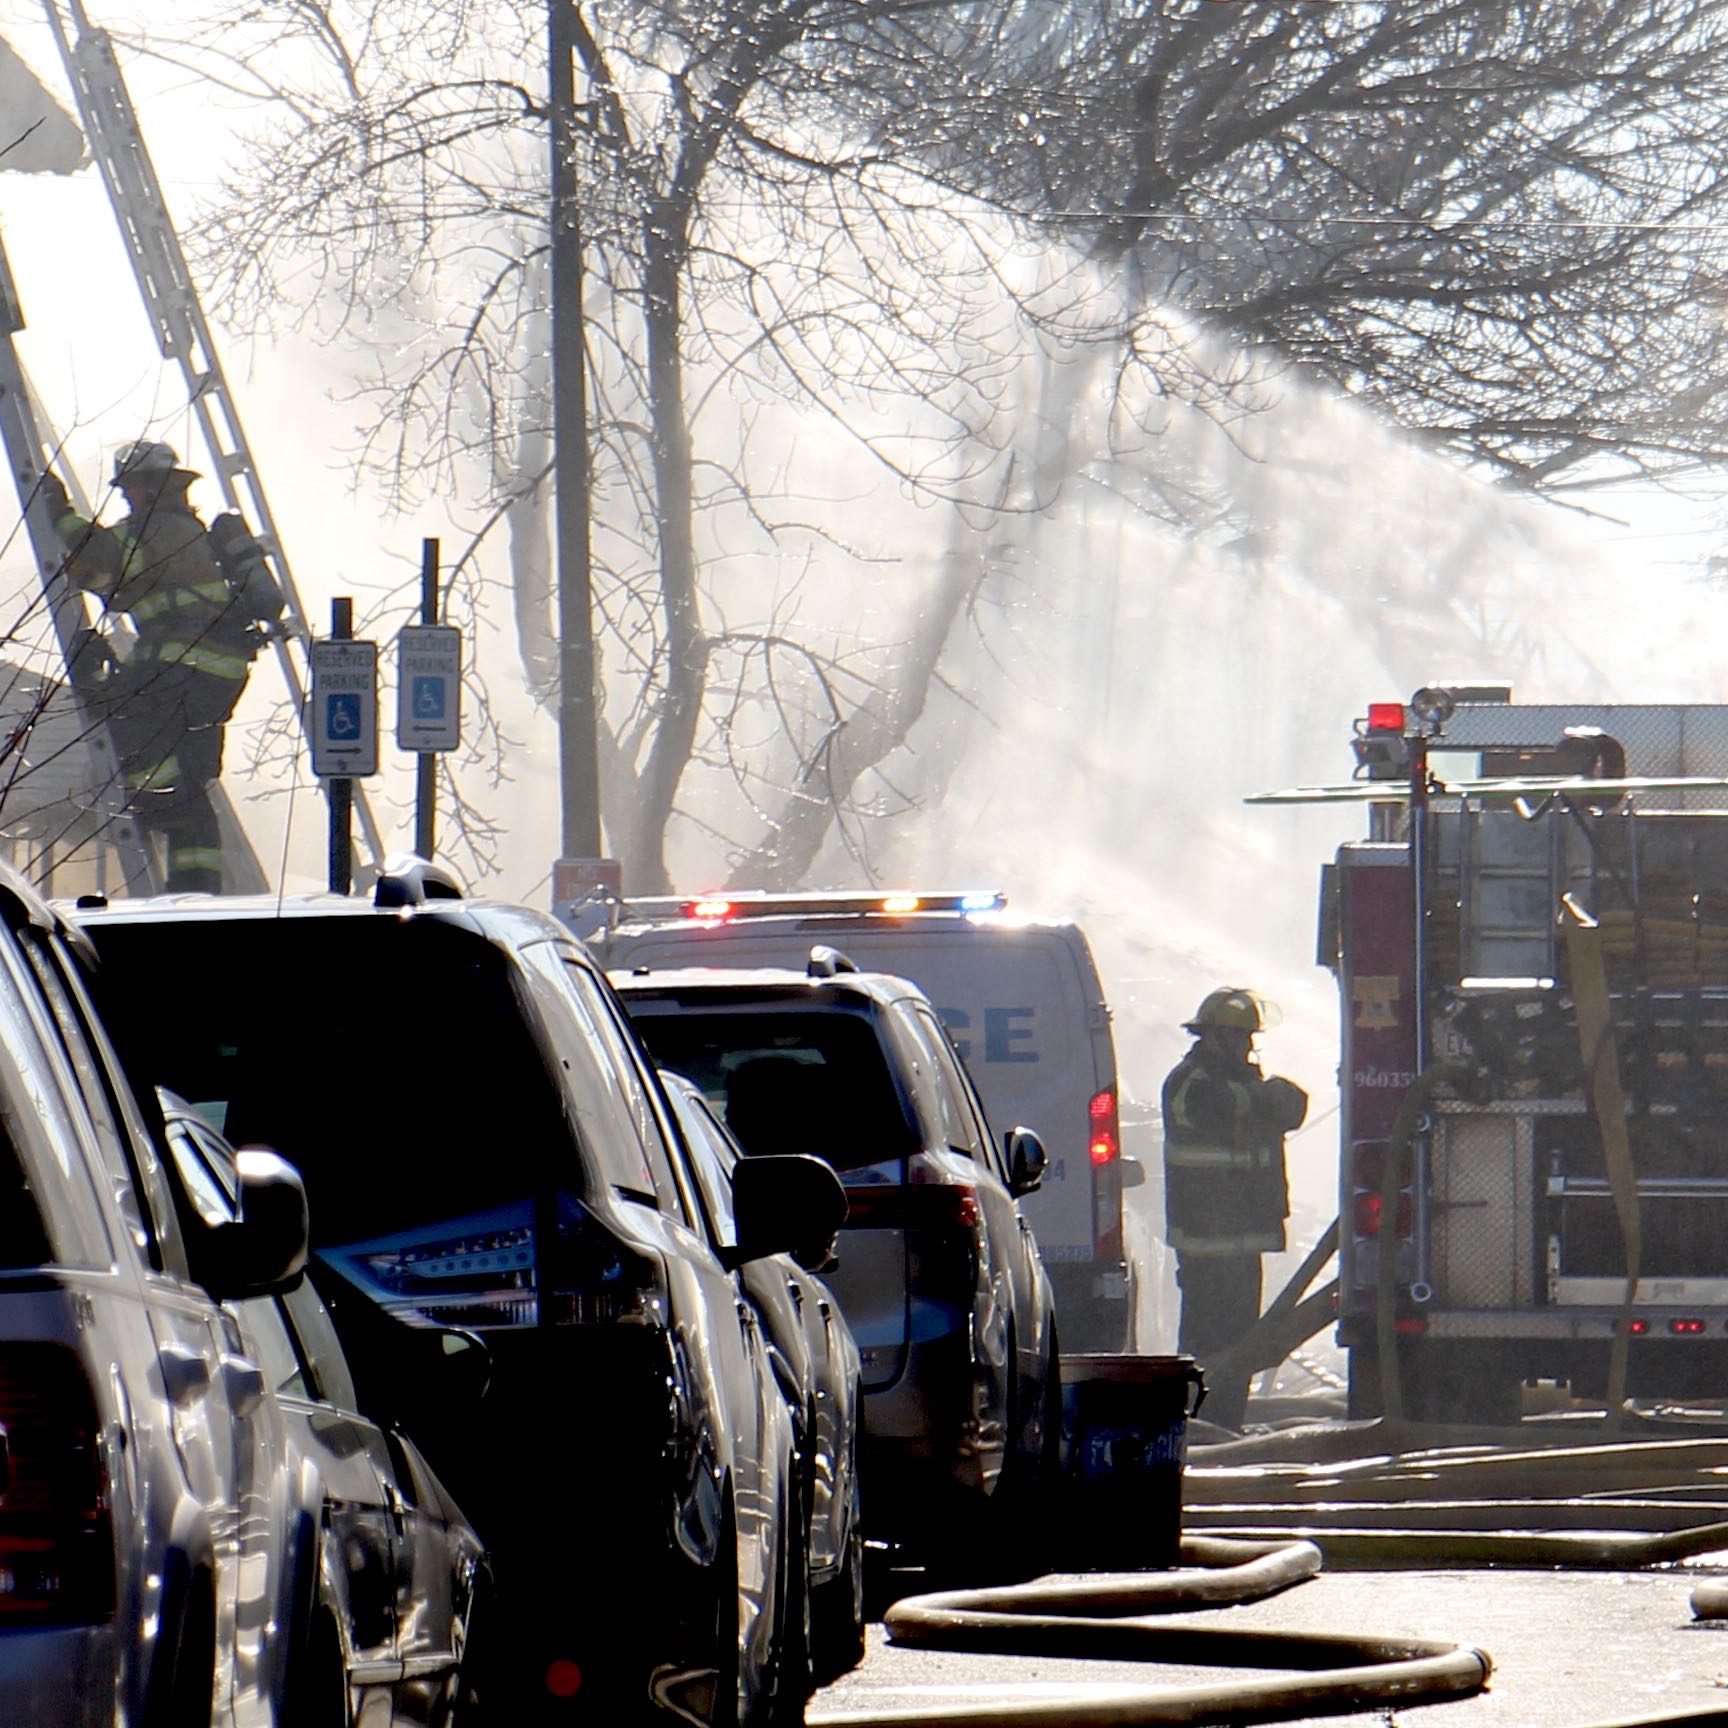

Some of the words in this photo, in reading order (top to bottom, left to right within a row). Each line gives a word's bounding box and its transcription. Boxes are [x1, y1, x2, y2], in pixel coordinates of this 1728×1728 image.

[405, 636, 456, 652] RESERVED
[316, 650, 373, 668] RESERVED
[406, 657, 453, 674] PARKING
[319, 674, 369, 690] PARKING
[1354, 1071, 1417, 1088] 96035
